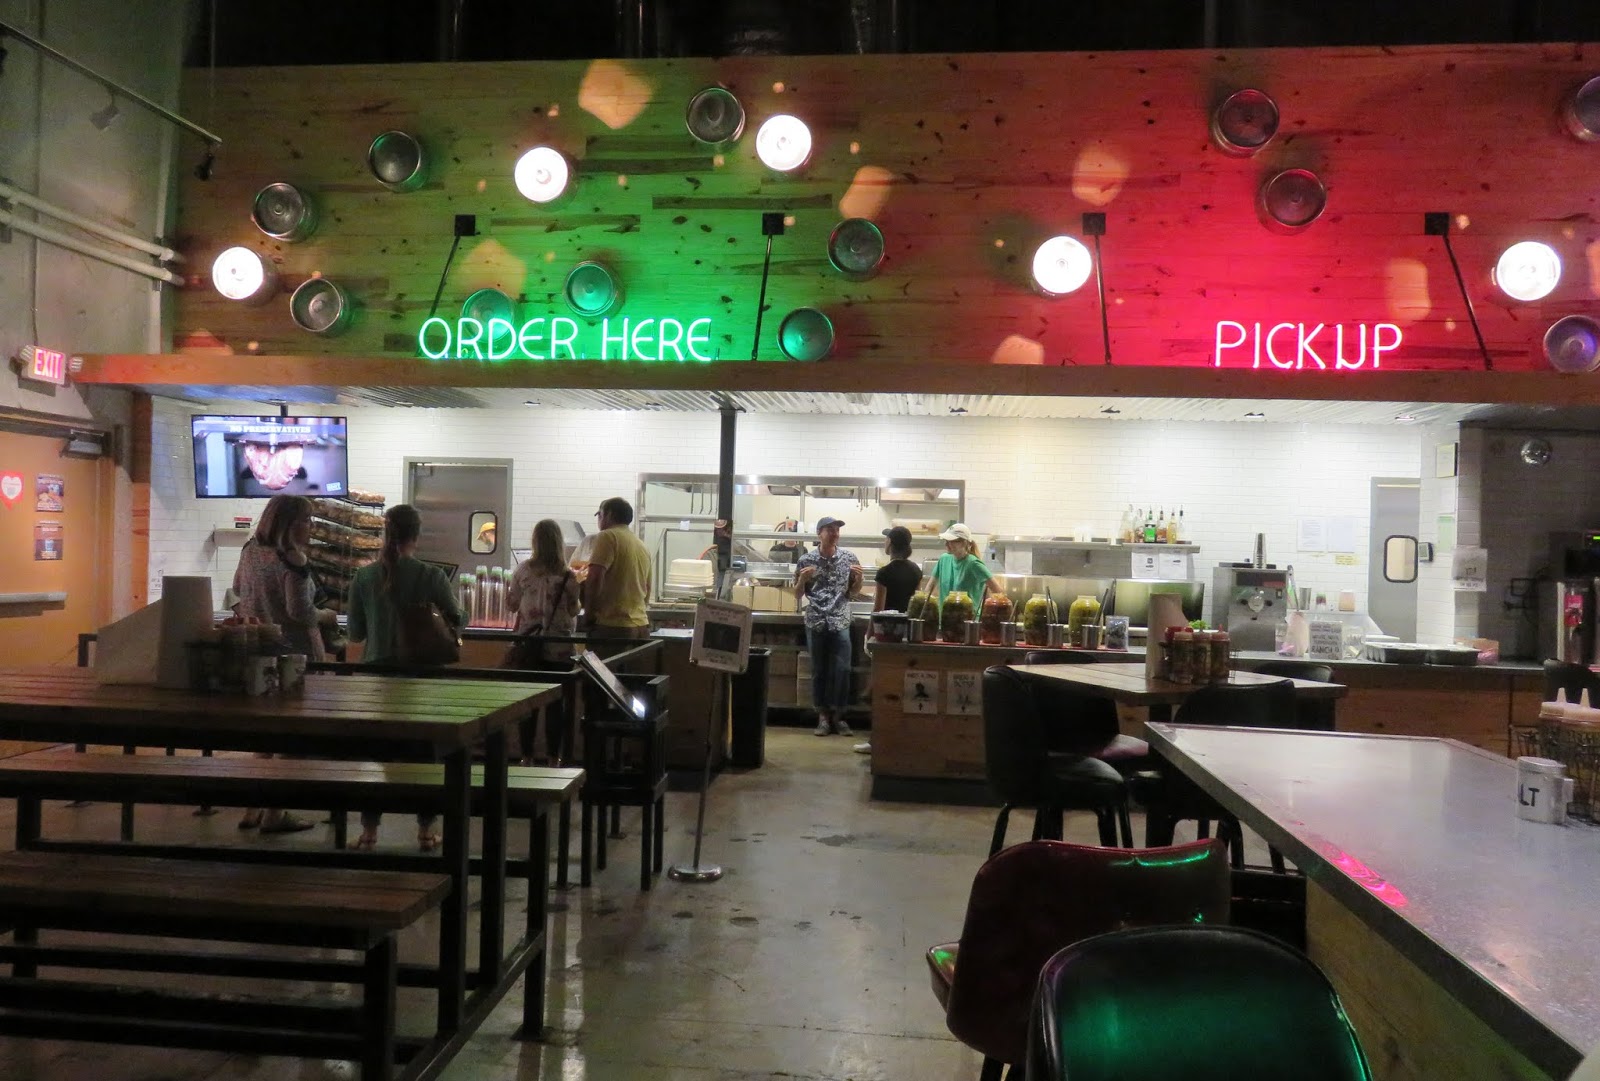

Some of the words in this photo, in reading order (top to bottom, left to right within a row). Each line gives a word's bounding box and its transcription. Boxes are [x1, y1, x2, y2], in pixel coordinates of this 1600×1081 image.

[418, 317, 578, 360] ORDER
[601, 317, 712, 361] HERE
[1214, 321, 1403, 370] PICKUP
[33, 348, 63, 379] EXIT
[243, 425, 312, 434] PRESERVATIVES
